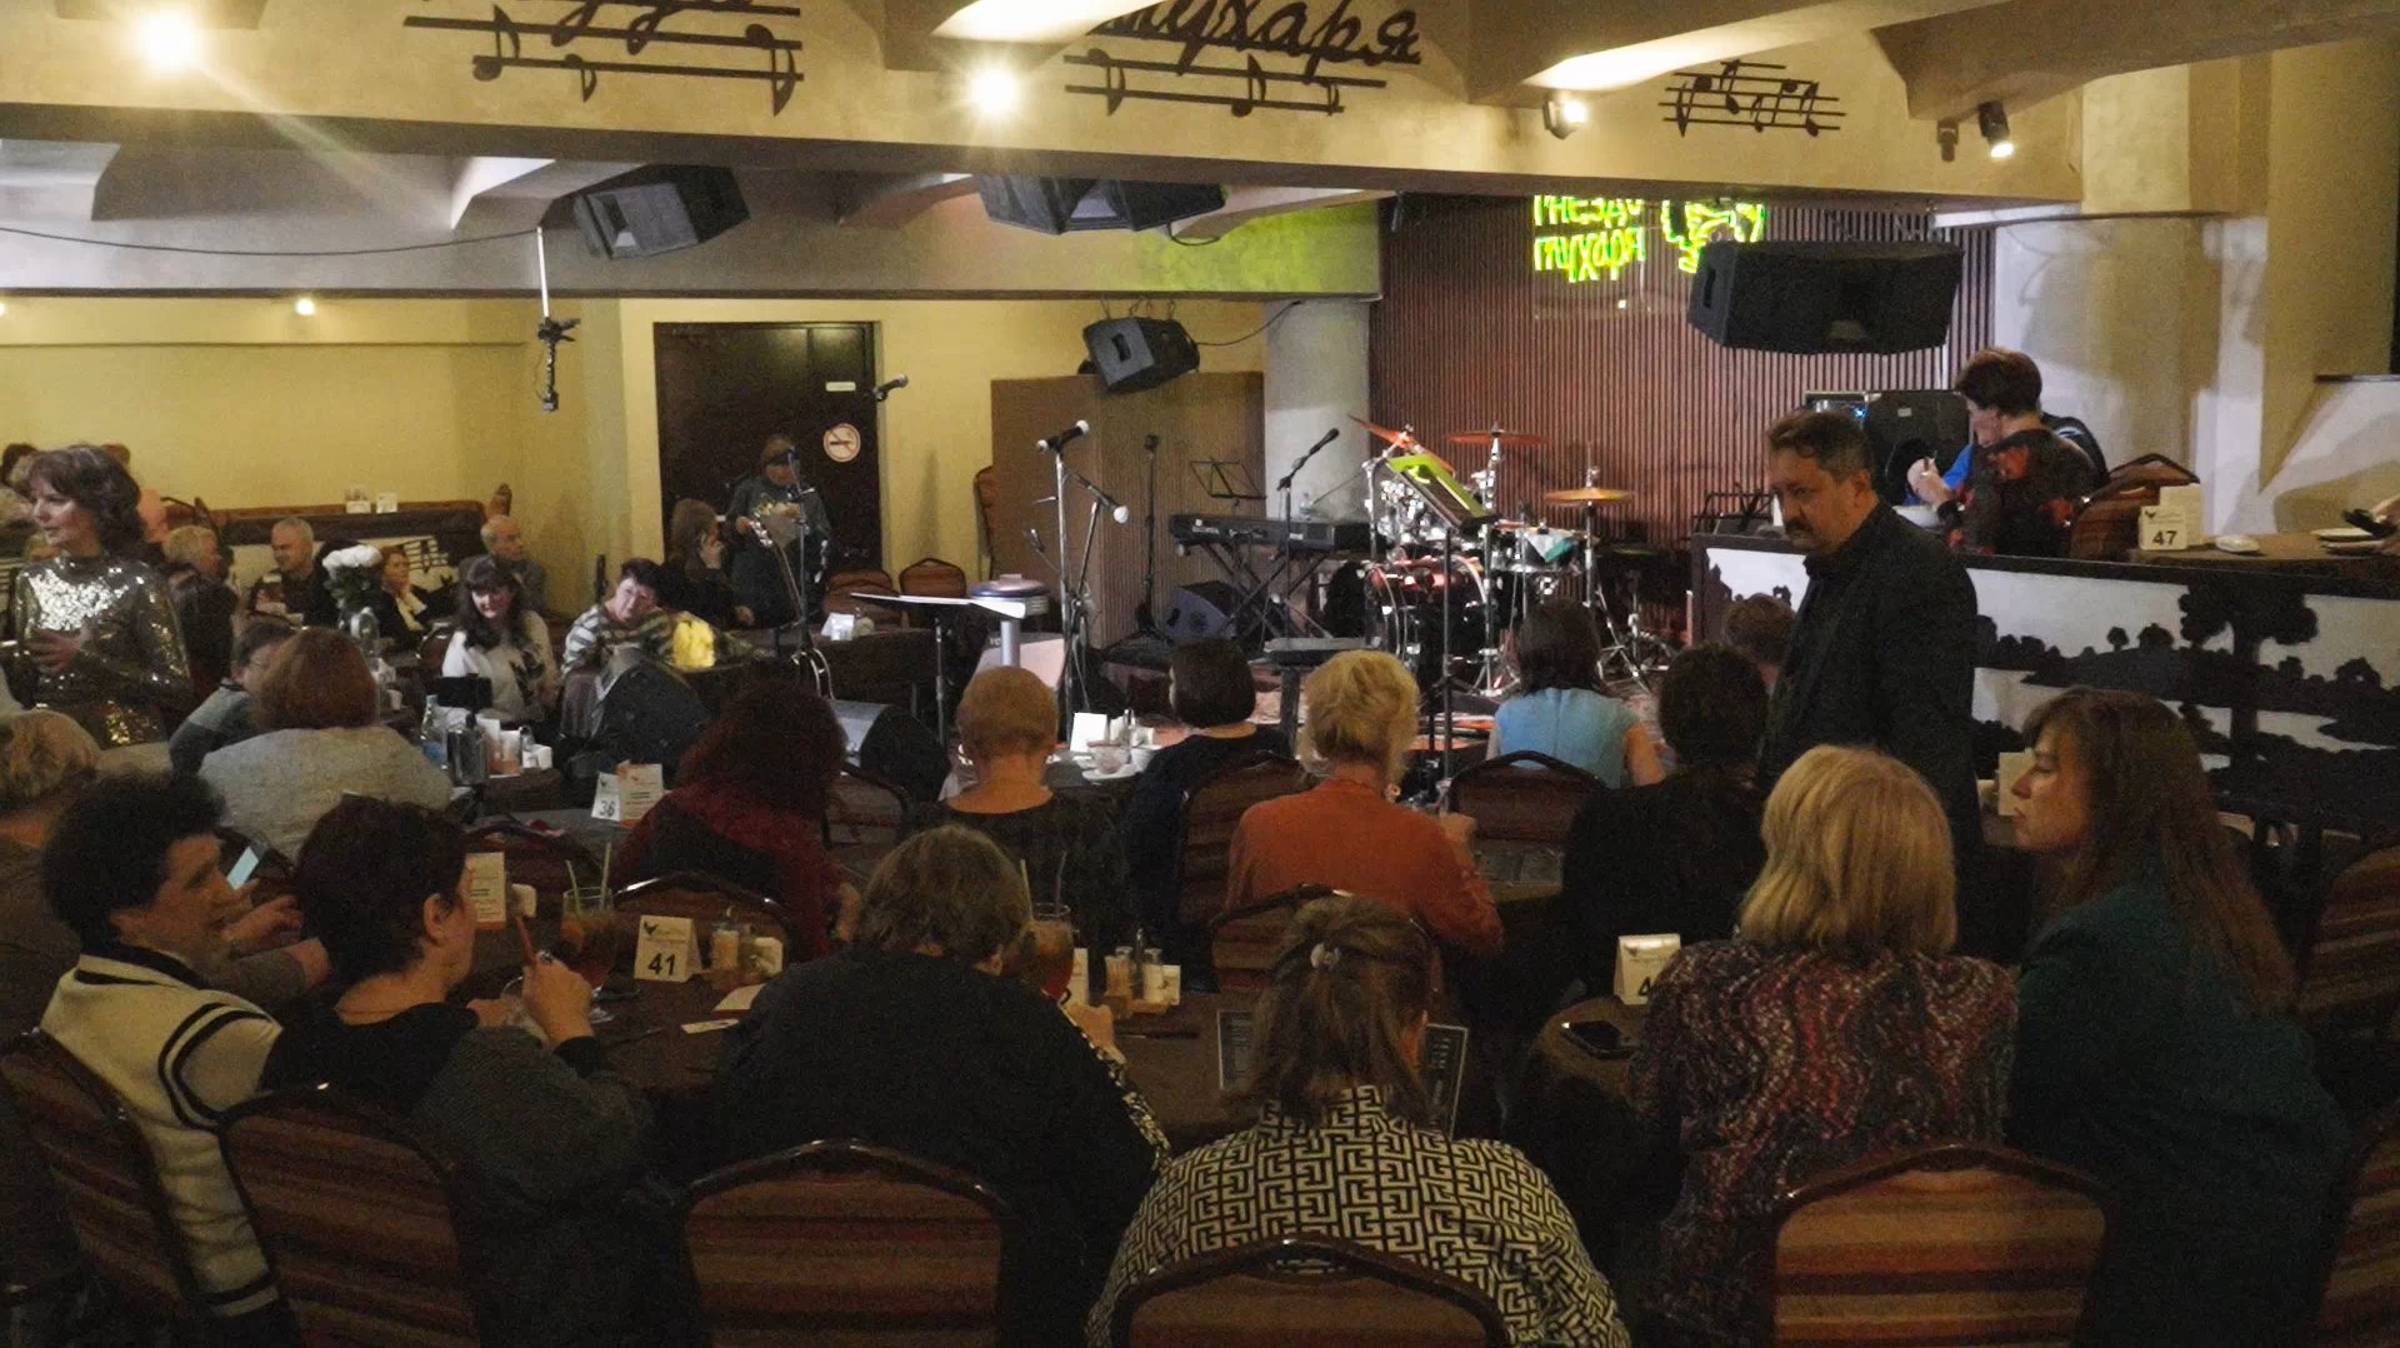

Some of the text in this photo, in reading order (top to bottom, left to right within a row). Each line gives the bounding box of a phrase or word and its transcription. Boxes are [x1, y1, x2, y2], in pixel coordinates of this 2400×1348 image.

[2151, 529, 2178, 546] 47
[598, 799, 617, 818] 36
[647, 952, 677, 977] 41
